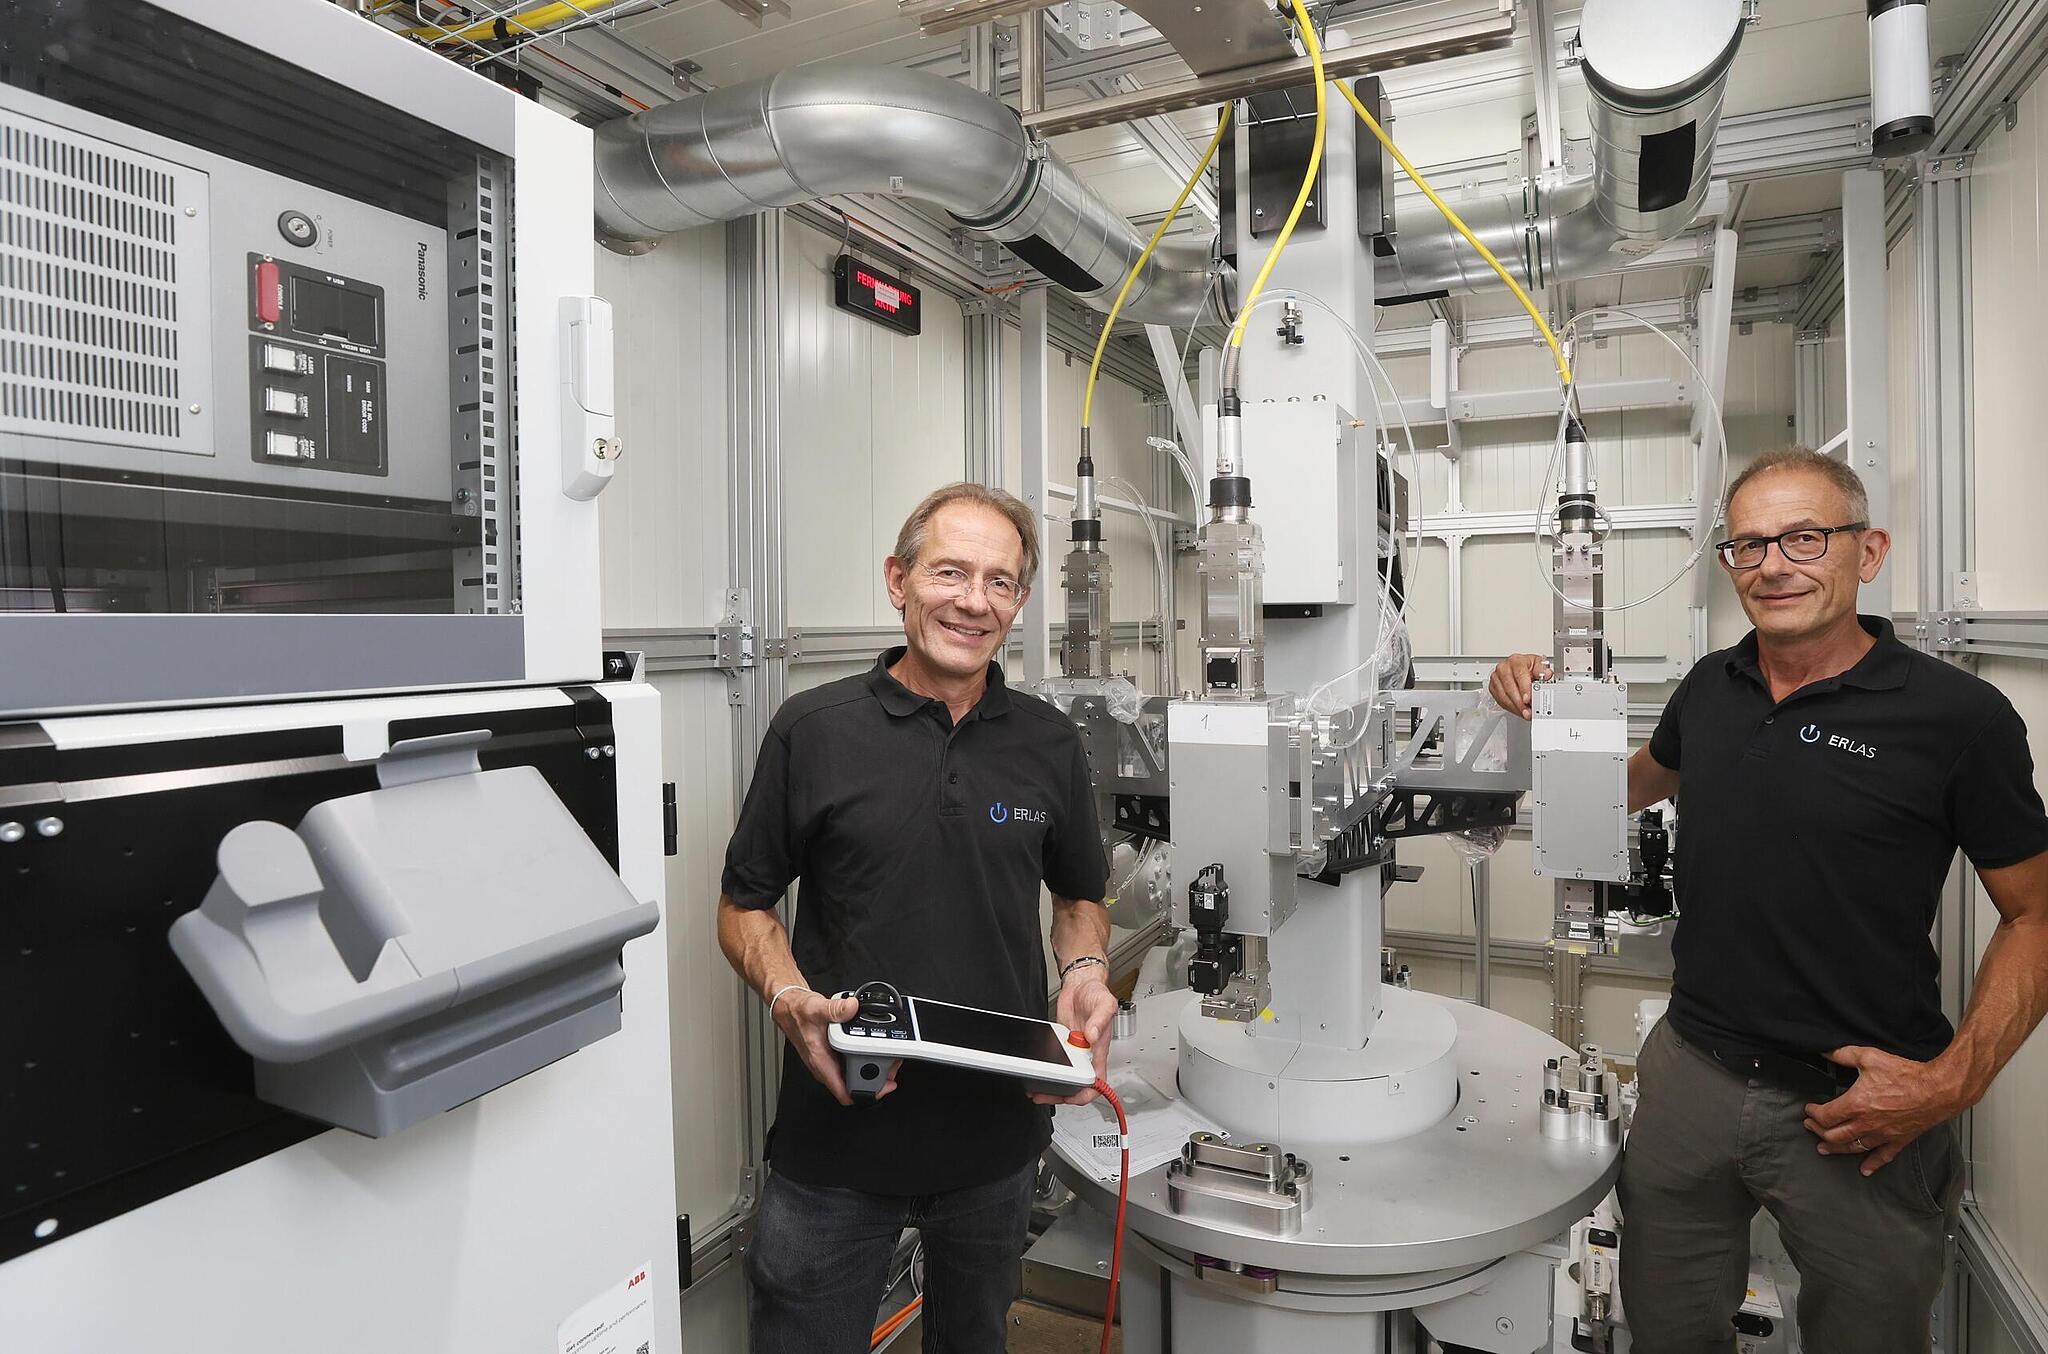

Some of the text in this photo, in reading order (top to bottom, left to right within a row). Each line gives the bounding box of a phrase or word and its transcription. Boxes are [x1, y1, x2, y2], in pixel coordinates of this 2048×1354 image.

[418, 242, 428, 301] Panasonic
[1200, 714, 1208, 729] 1
[1569, 727, 1581, 741] 4
[1828, 734, 1877, 759] ERLAS
[1013, 807, 1047, 823] ERLAS
[627, 1271, 646, 1289] ABB
